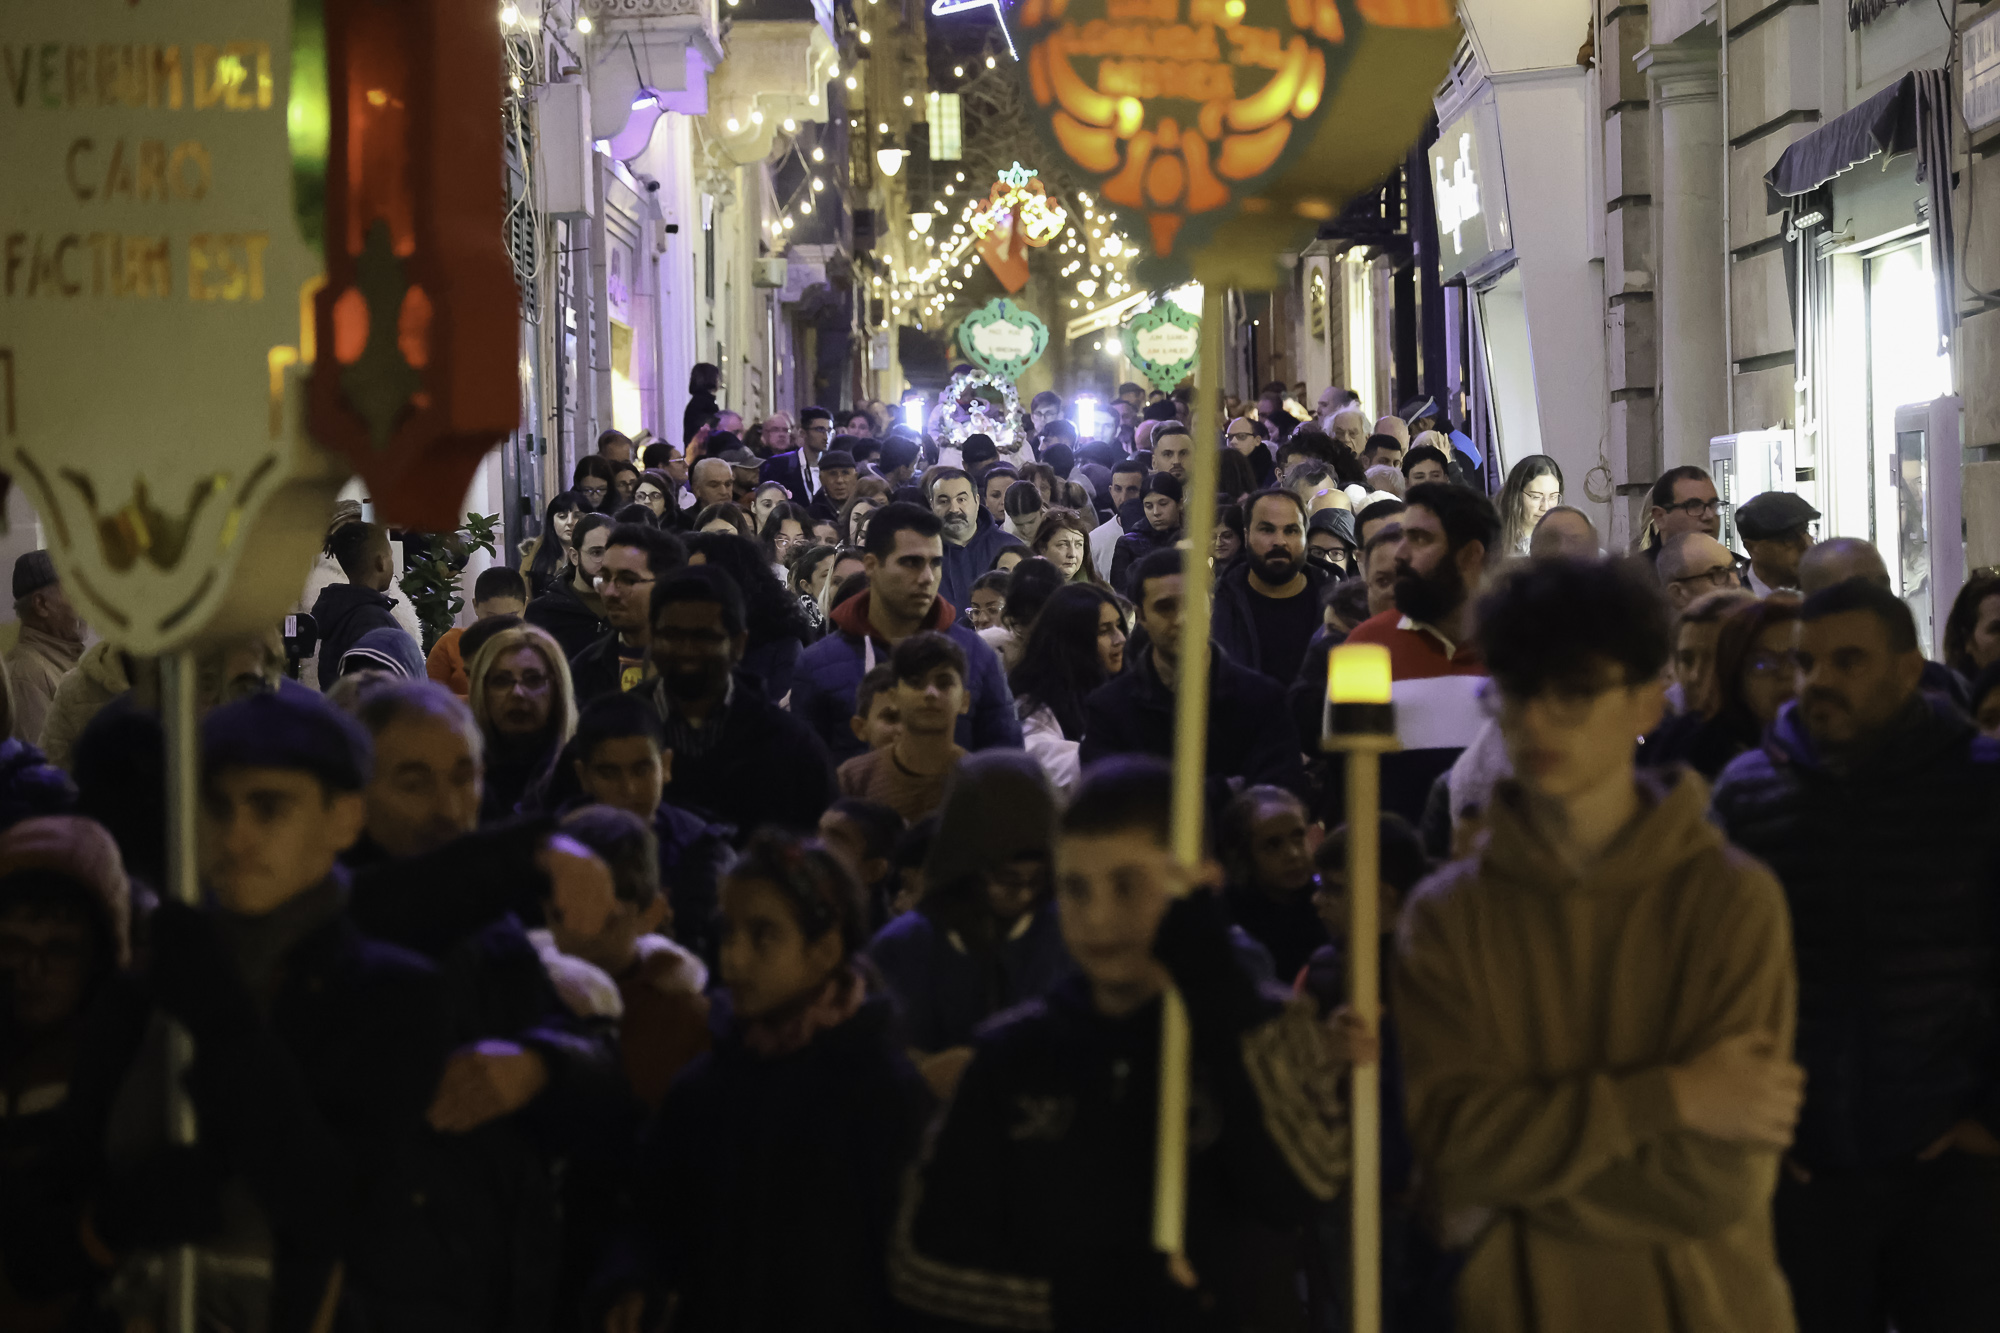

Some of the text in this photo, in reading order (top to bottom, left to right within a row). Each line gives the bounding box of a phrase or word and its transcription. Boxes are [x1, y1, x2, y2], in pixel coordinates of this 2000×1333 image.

[193, 39, 273, 111] DEI
[65, 137, 213, 201] CARO
[4, 230, 270, 301] FACTUM EST
